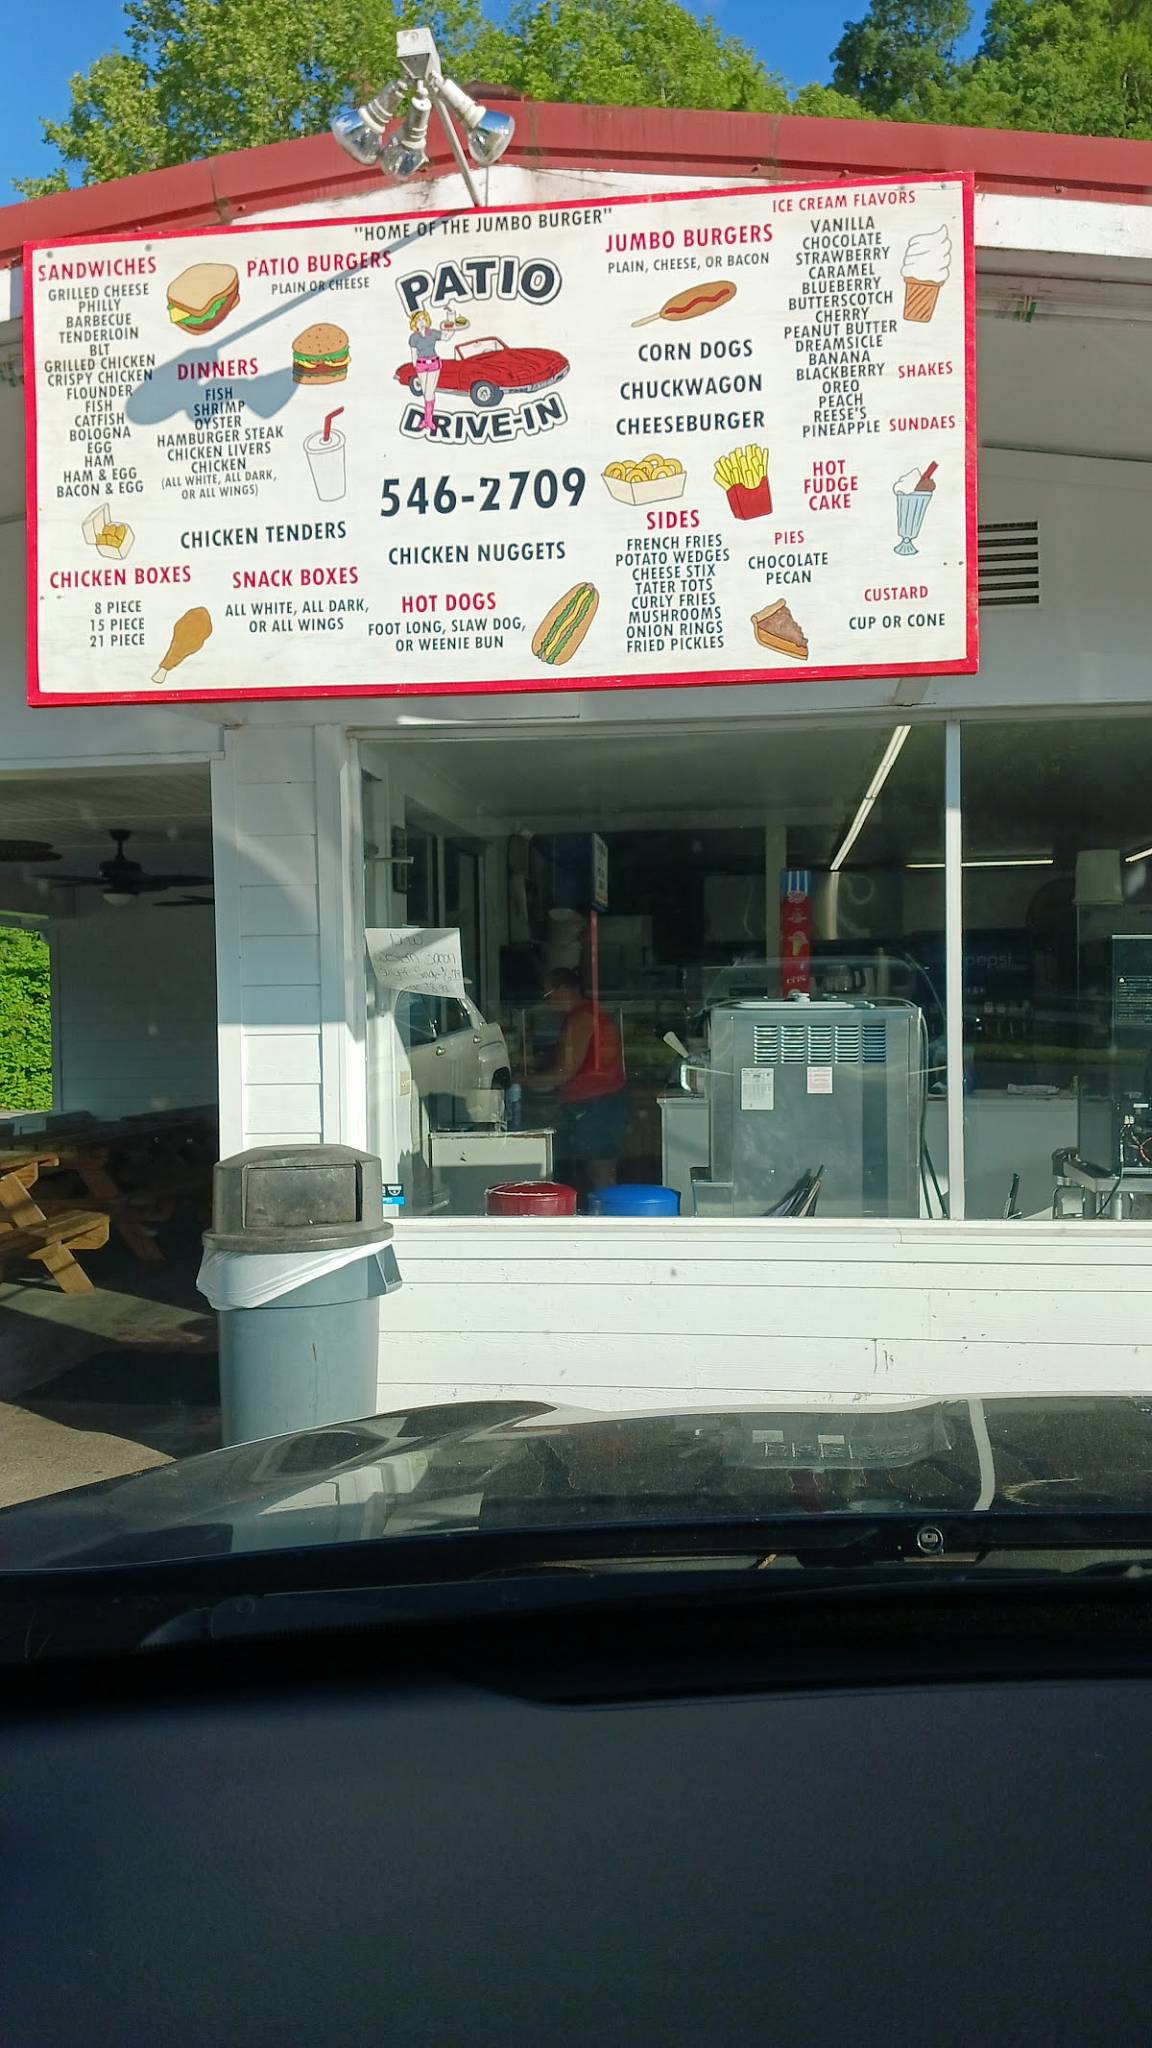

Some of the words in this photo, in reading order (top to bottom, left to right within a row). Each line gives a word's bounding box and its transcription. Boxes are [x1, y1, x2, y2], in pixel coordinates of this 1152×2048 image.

[773, 199, 794, 213] ICE
[798, 195, 848, 212] CREAM
[854, 191, 916, 208] FLAVORS
[354, 225, 410, 241] "HOME
[418, 223, 436, 236] OF
[442, 219, 470, 234] THE
[476, 215, 531, 232] JUMBO
[539, 208, 612, 228] BURGER"
[810, 216, 875, 234] VANILLA
[606, 230, 675, 252] JUMBO
[684, 224, 773, 247] BURGERS
[803, 232, 882, 250] CHOCOLATE
[247, 256, 299, 278] PATIO
[308, 251, 392, 272] BURGERS
[608, 260, 649, 274] PLAIN,
[654, 256, 700, 272] CHEESE,
[706, 255, 722, 268] OR
[727, 252, 770, 266] BACON
[796, 247, 890, 266] STRAWBERRY
[38, 257, 156, 281] SANDWICHES
[809, 264, 876, 280] CARAMEL
[49, 286, 98, 301] GRILLED
[104, 283, 149, 297] CHEESE
[272, 283, 305, 296] PLAIN
[310, 280, 326, 292] OR
[329, 277, 370, 290] CHEESE
[397, 257, 559, 316] PATIO
[802, 277, 881, 295] BLUEBERRY
[79, 298, 121, 312] PHILLY
[789, 291, 892, 310] BUTTERSCOTCH
[66, 314, 132, 328] BARBECUE
[816, 306, 868, 323] CHERRY
[59, 328, 139, 343] TENDERLOIN
[784, 323, 840, 340] PEANUT
[846, 320, 898, 336] BUTTER
[90, 344, 110, 356] BLT
[638, 342, 691, 362] CORN
[701, 340, 753, 360] DOGS
[796, 334, 884, 352] DREAMSICLE
[44, 358, 96, 372] GRILLED
[101, 354, 156, 369] CHICKEN
[809, 350, 870, 366] BANANA
[48, 372, 92, 386] CRISPY
[98, 370, 152, 384] CHICKEN
[178, 358, 258, 380] DINNERS
[796, 363, 885, 381] BLACKBERRY
[898, 361, 953, 379] SHAKES
[67, 386, 133, 399] FLOUNDER
[205, 388, 233, 400] FISH
[620, 374, 762, 400] CHUCKWAGON
[822, 380, 859, 394] OREO
[85, 400, 112, 412] FISH
[194, 400, 245, 416] SHRIMP
[819, 393, 863, 408] PEACH
[75, 413, 124, 428] CATFISH
[195, 415, 241, 430] OYSTER
[402, 394, 565, 441] DRIVE-IN
[616, 411, 764, 436] CHEESEBURGER
[814, 407, 867, 423] REESE'S
[890, 415, 955, 432] SUNDAES
[70, 427, 130, 442] BOLOGNA
[157, 430, 240, 448] HAMBURGER
[245, 426, 284, 440] STEAK
[802, 420, 880, 438] PINEAPPLE
[88, 441, 112, 454] EGG
[168, 446, 222, 461] CHICKEN
[228, 442, 272, 456] LIVERS
[84, 454, 114, 468] HAM
[191, 458, 246, 474] CHICKEN
[813, 460, 845, 476] HOT
[64, 469, 93, 482] HAM
[98, 468, 107, 480] &
[112, 467, 137, 480] EGG
[162, 475, 182, 490] (ALL
[185, 472, 221, 487] WHITE,
[224, 471, 242, 483] ALL
[245, 470, 277, 483] DARK,
[57, 483, 100, 498] BACON
[106, 482, 114, 494] &
[120, 481, 144, 494] EGG
[182, 489, 196, 500] OR
[199, 487, 215, 498] ALL
[220, 484, 258, 498] WINGS)
[380, 467, 586, 518] 546-2709
[804, 476, 858, 494] FUDGE
[809, 494, 851, 512] CAKE
[647, 510, 700, 530] SIDES
[181, 527, 258, 549] CHICKEN
[266, 520, 347, 542] TENDERS
[627, 536, 680, 551] FRENCH
[686, 534, 722, 548] FRIES
[774, 530, 804, 545] PIES
[388, 546, 469, 565] CHICKEN
[478, 541, 566, 562] NUGGETS
[616, 551, 668, 567] POTATO
[674, 548, 730, 563] WEDGES
[748, 552, 828, 570] CHOCOLATE
[50, 568, 126, 588] CHICKEN
[135, 566, 191, 584] BOXES
[232, 570, 292, 588] SNACK
[301, 566, 358, 585] BOXES
[632, 566, 682, 581] CHEESE
[686, 564, 716, 578] STIX
[766, 570, 812, 586] PECAN
[635, 581, 676, 594] TATER
[680, 578, 712, 592] TOTS
[864, 586, 928, 602] CUSTARD
[94, 602, 101, 614] 8
[107, 600, 142, 614] PIECE
[225, 604, 246, 616] ALL
[252, 602, 297, 616] WHITE,
[302, 600, 323, 613] ALL
[329, 598, 369, 613] DARK,
[402, 596, 438, 613] HOT
[446, 592, 496, 612] DOGS
[632, 594, 675, 609] CURLY
[679, 592, 716, 606] FRIES
[628, 606, 722, 624] MUSHROOMS
[849, 616, 876, 630] CUP
[884, 615, 901, 628] OR
[907, 612, 946, 628] CONE
[90, 618, 104, 632] 15
[110, 618, 144, 631] PIECE
[249, 620, 266, 633] OR
[271, 620, 293, 632] ALL
[298, 617, 344, 632] WINGS
[368, 623, 400, 636] FOOT
[406, 620, 446, 634] LONG,
[452, 618, 488, 633] SLAW
[493, 617, 526, 632] DOG,
[626, 623, 676, 639] ONION
[680, 620, 723, 636] RINGS
[90, 634, 104, 647] 21
[110, 633, 144, 646] PIECE
[396, 640, 414, 652] OR
[418, 637, 470, 651] WEENIE
[476, 636, 504, 648] BUN
[626, 638, 665, 653] FRIED
[670, 636, 724, 650] PICKLES
